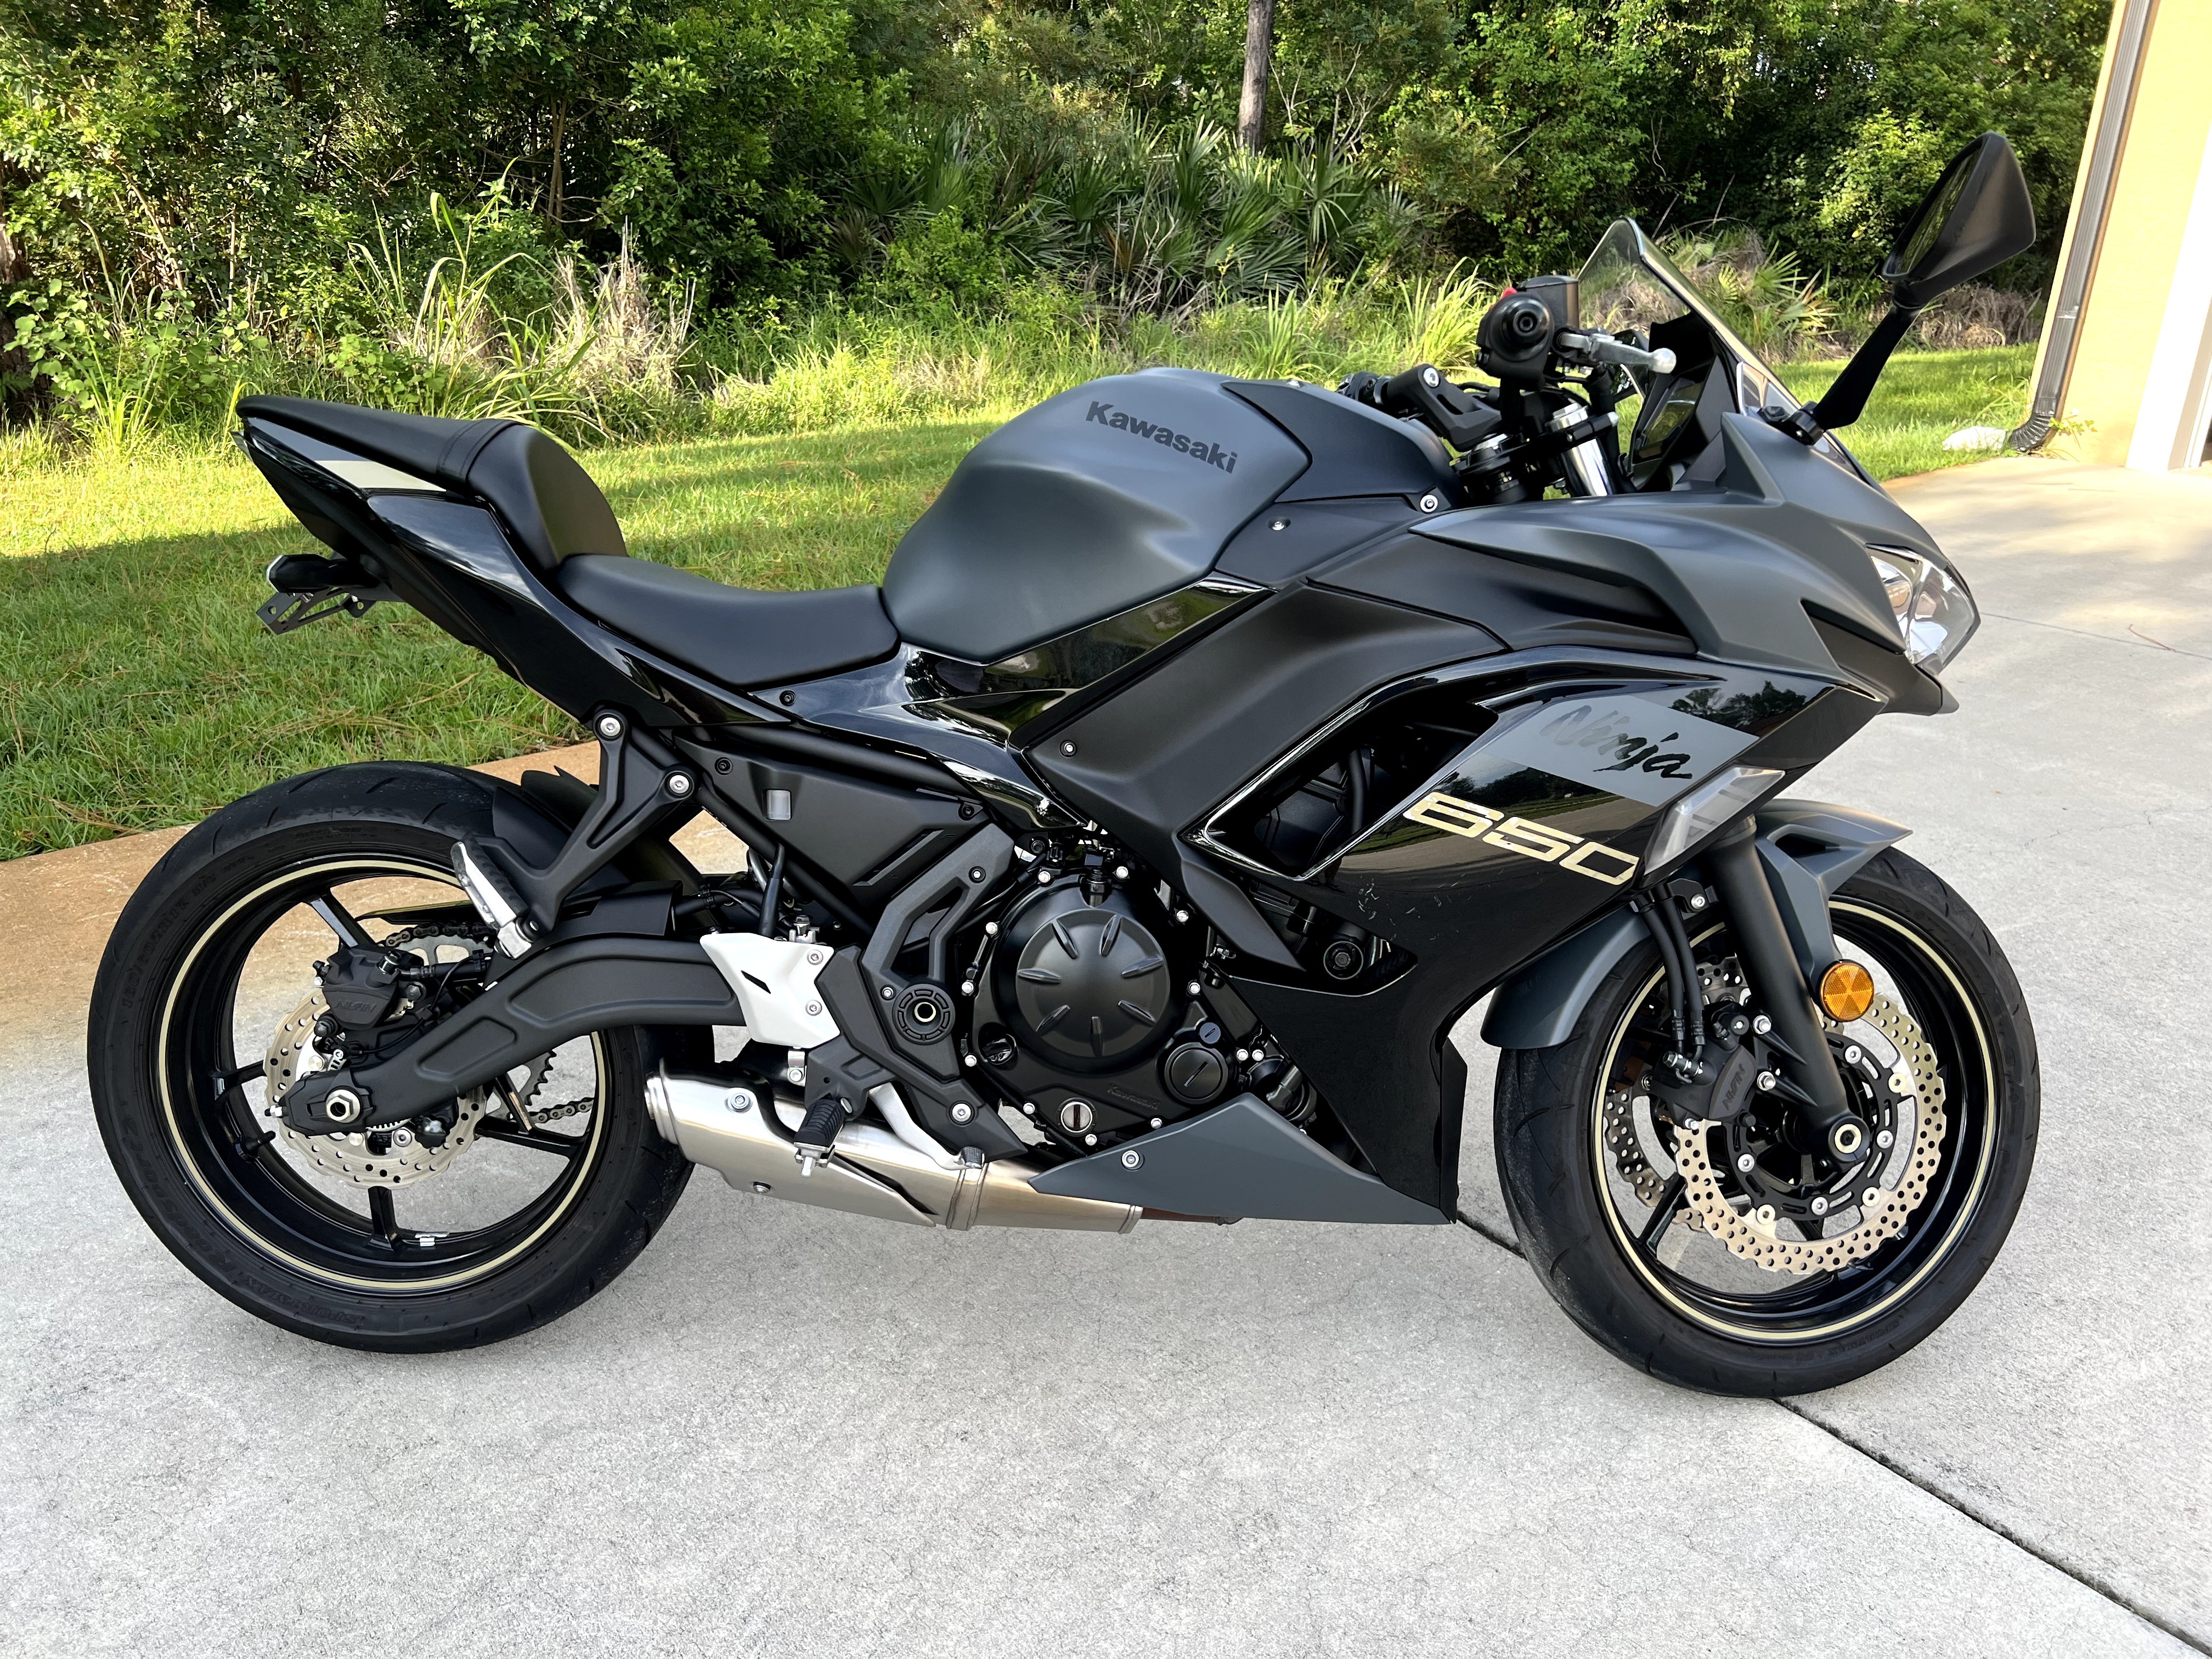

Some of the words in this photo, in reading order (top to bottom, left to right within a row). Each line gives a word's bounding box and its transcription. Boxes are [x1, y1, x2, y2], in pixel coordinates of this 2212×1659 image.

[1086, 401, 1238, 473] Kawasaki
[1539, 705, 1692, 779] Ninja
[1402, 791, 1640, 885] 650
